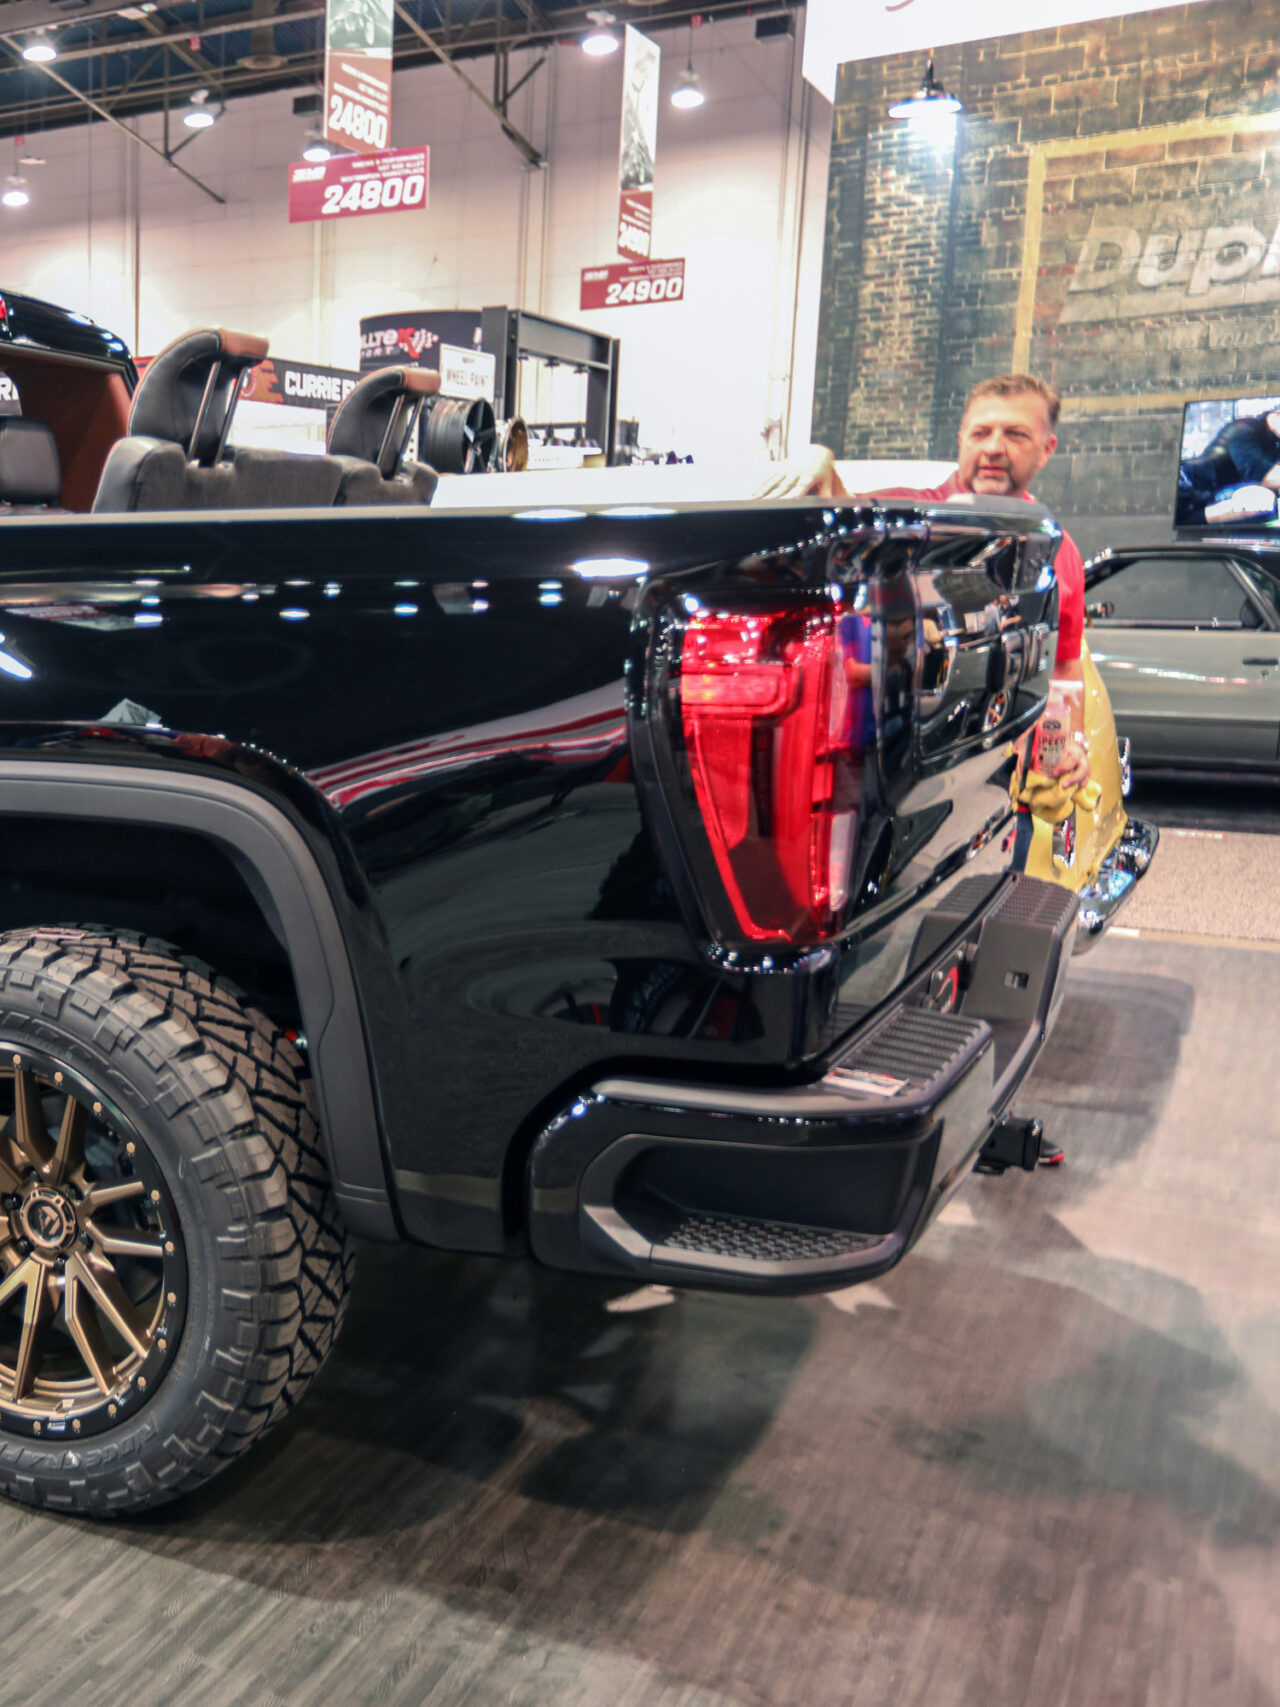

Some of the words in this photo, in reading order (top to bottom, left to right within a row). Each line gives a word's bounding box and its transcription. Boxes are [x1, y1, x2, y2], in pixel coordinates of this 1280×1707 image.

[328, 94, 388, 149] 24800
[321, 175, 425, 215] 24800
[605, 277, 683, 305] 24900
[285, 370, 341, 402] CURRIE
